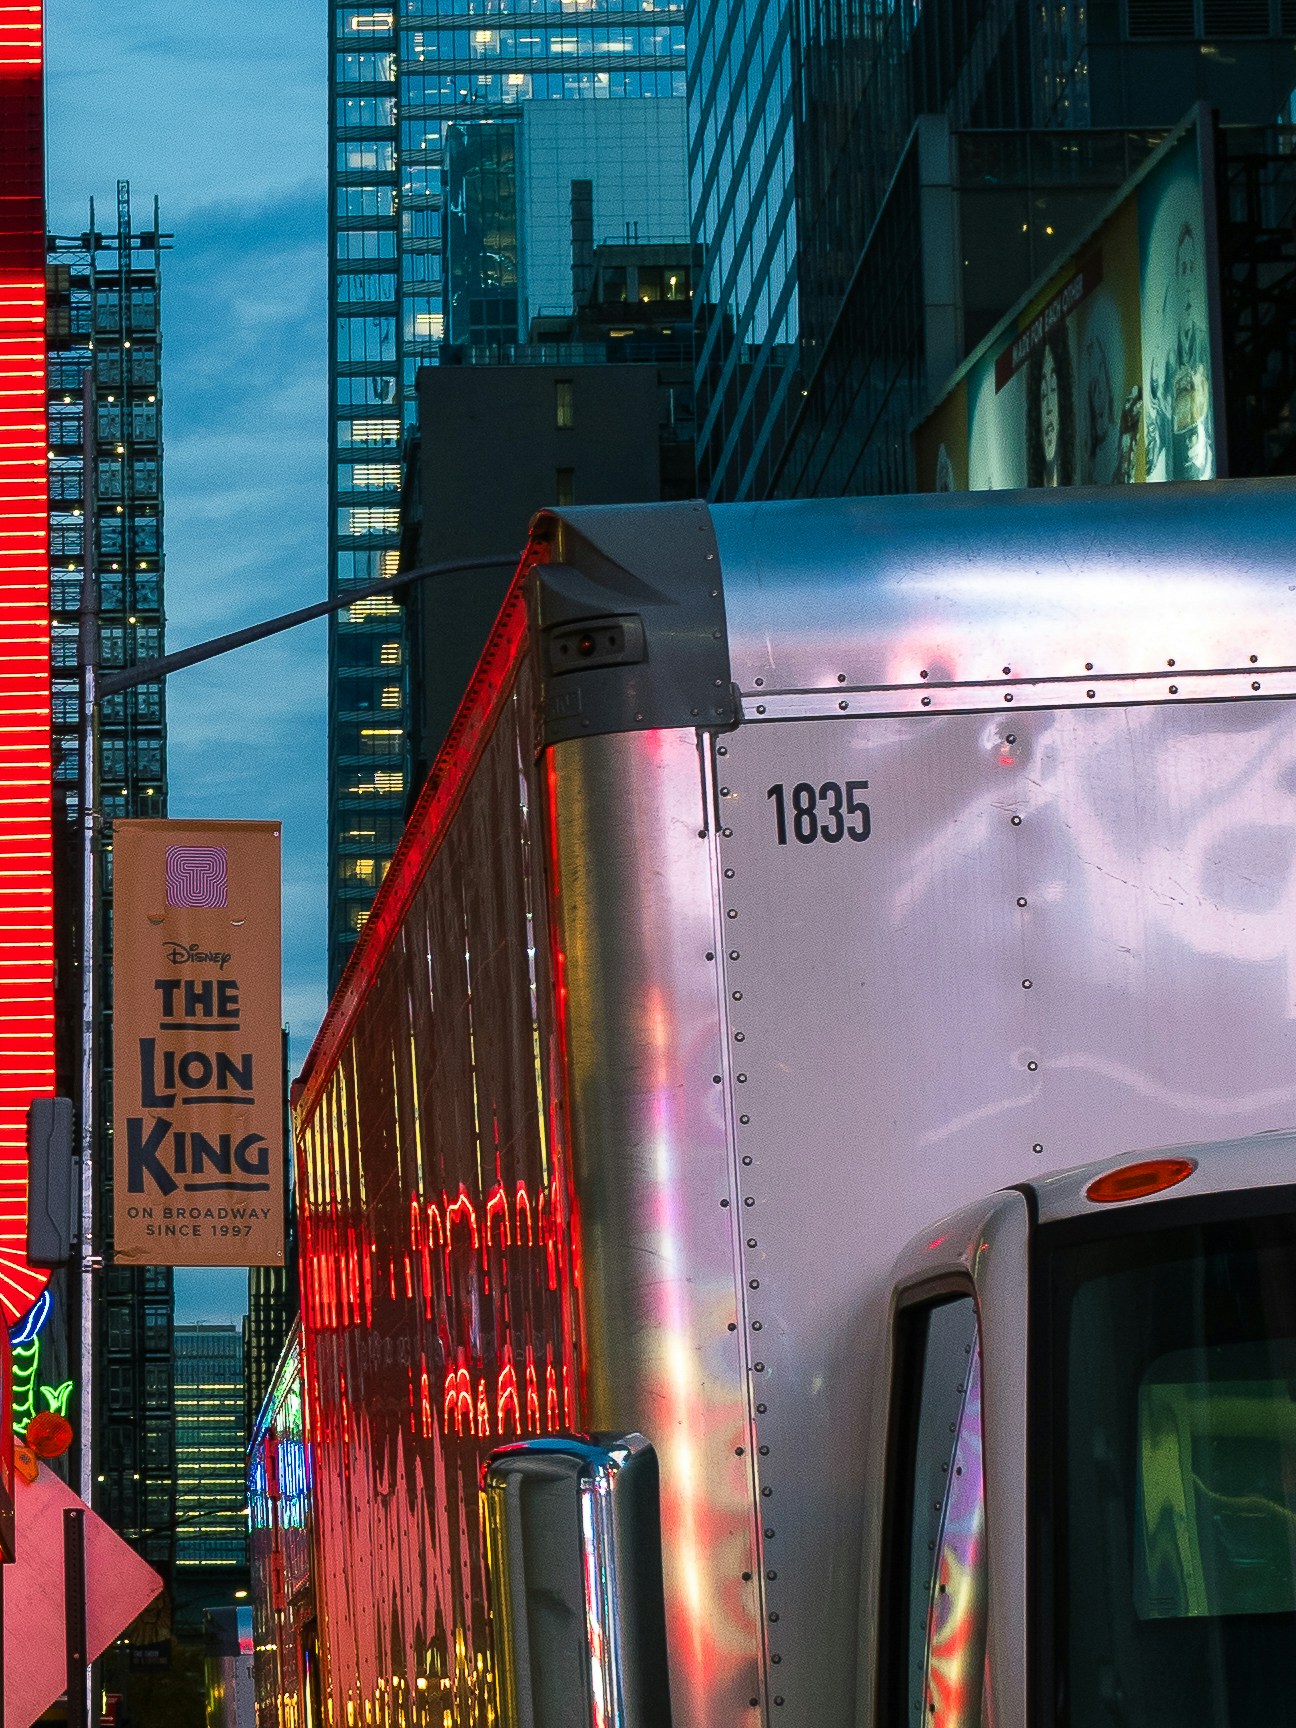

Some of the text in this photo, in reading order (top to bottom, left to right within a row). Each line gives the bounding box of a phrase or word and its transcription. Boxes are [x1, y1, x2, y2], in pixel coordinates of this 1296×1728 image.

[766, 779, 872, 846] 1835
[154, 978, 241, 1018] THE
[138, 1037, 254, 1109] LION
[125, 1116, 270, 1197] KING
[127, 1206, 272, 1221] ON BROADWAY
[145, 1223, 254, 1238] SINCE 1997
